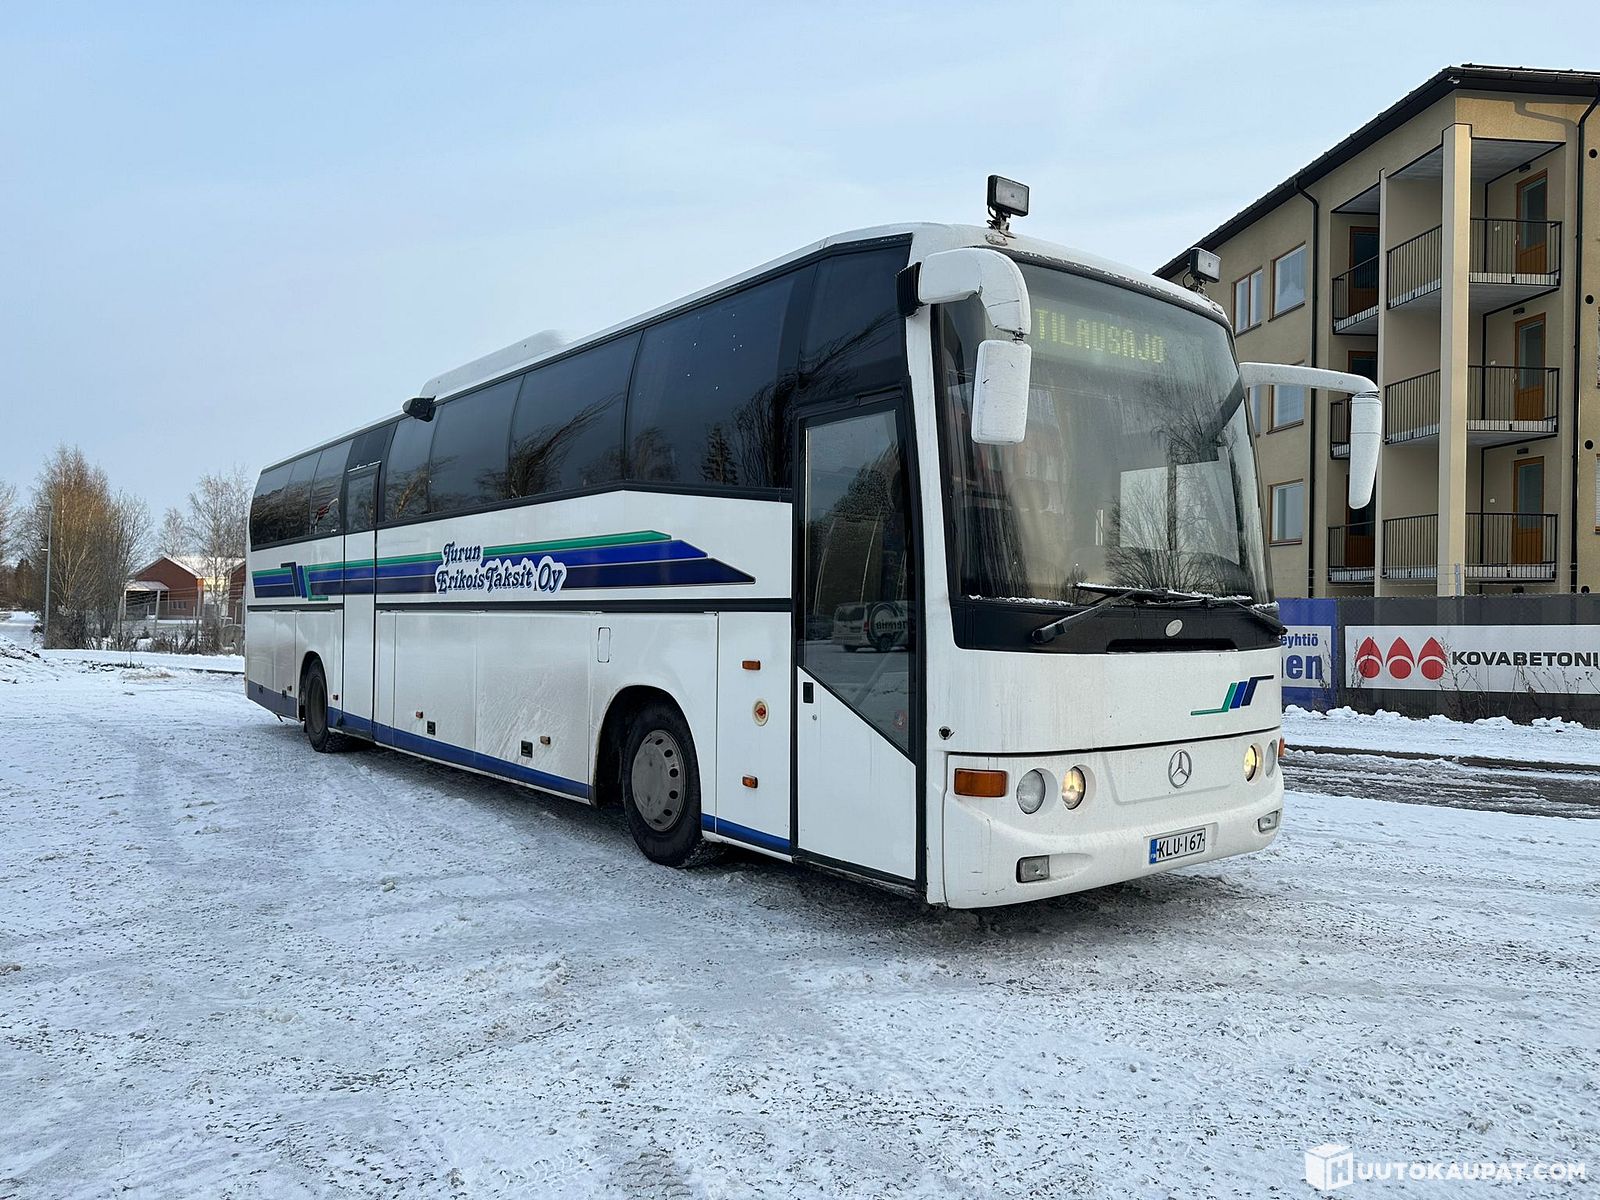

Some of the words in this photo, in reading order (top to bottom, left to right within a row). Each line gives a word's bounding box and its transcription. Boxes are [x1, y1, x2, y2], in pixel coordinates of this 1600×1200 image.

[1034, 307, 1167, 363] TILAUSAJO
[443, 541, 481, 566] Turun
[436, 564, 534, 593] ErikoisTaksit
[538, 562, 563, 593] Oy
[1281, 654, 1323, 680] en
[1451, 651, 1600, 667] KOVABETONI
[1157, 832, 1204, 858] KLU-167
